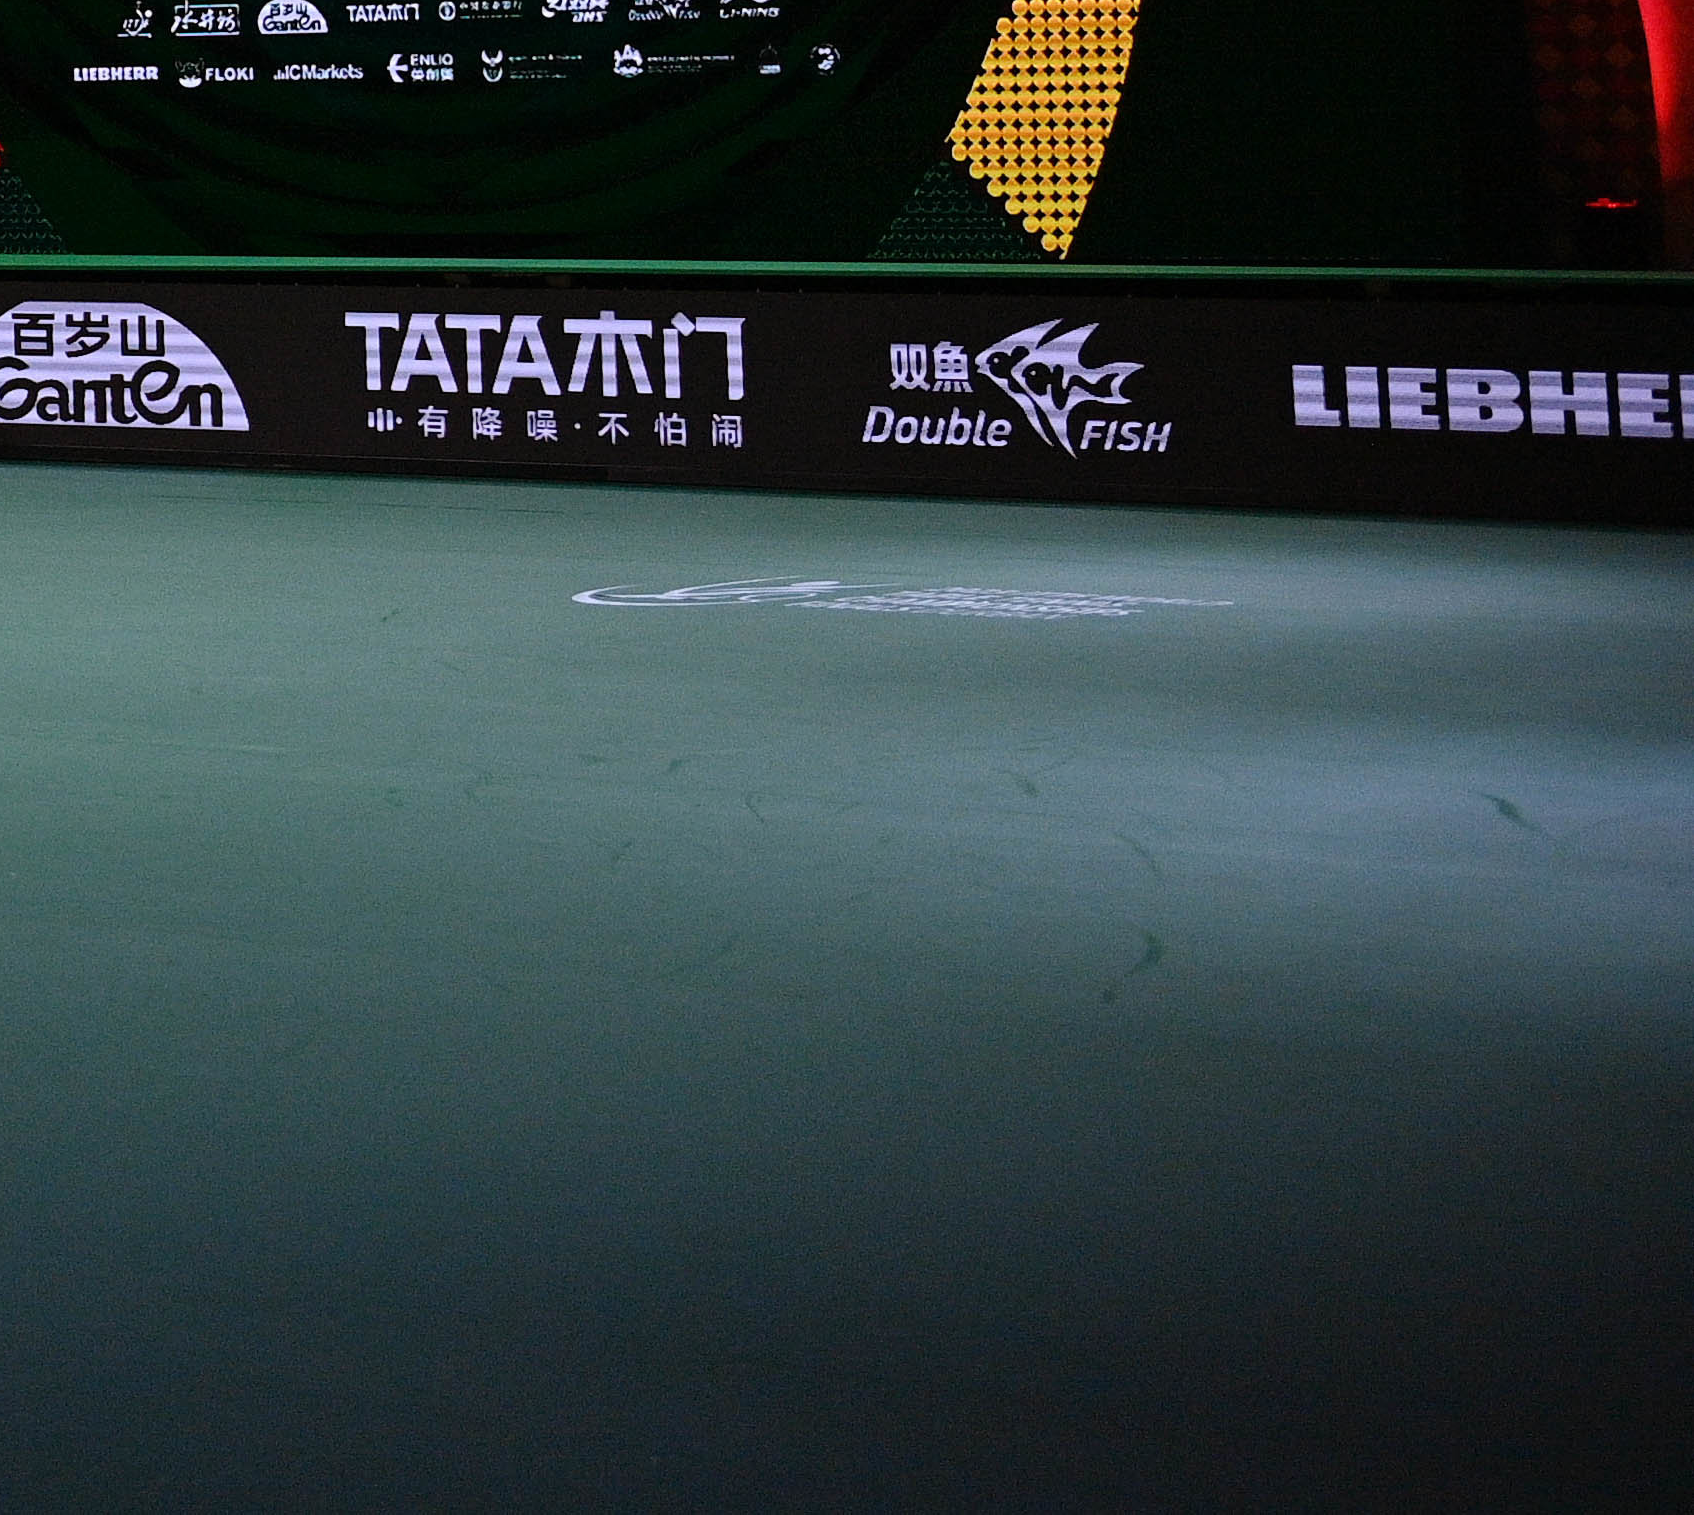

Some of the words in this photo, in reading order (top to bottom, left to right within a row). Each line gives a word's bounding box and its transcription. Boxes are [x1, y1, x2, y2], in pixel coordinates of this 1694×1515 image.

[73, 66, 158, 81] LIEBHERR
[205, 67, 254, 81] FLOKI
[410, 53, 453, 66] ENLIO
[11, 311, 165, 358] 百岁山
[344, 310, 746, 401] TATA木门
[1292, 364, 1694, 439] LIEBHE
[862, 405, 1012, 448] Double
[1080, 419, 1173, 453] FISH
